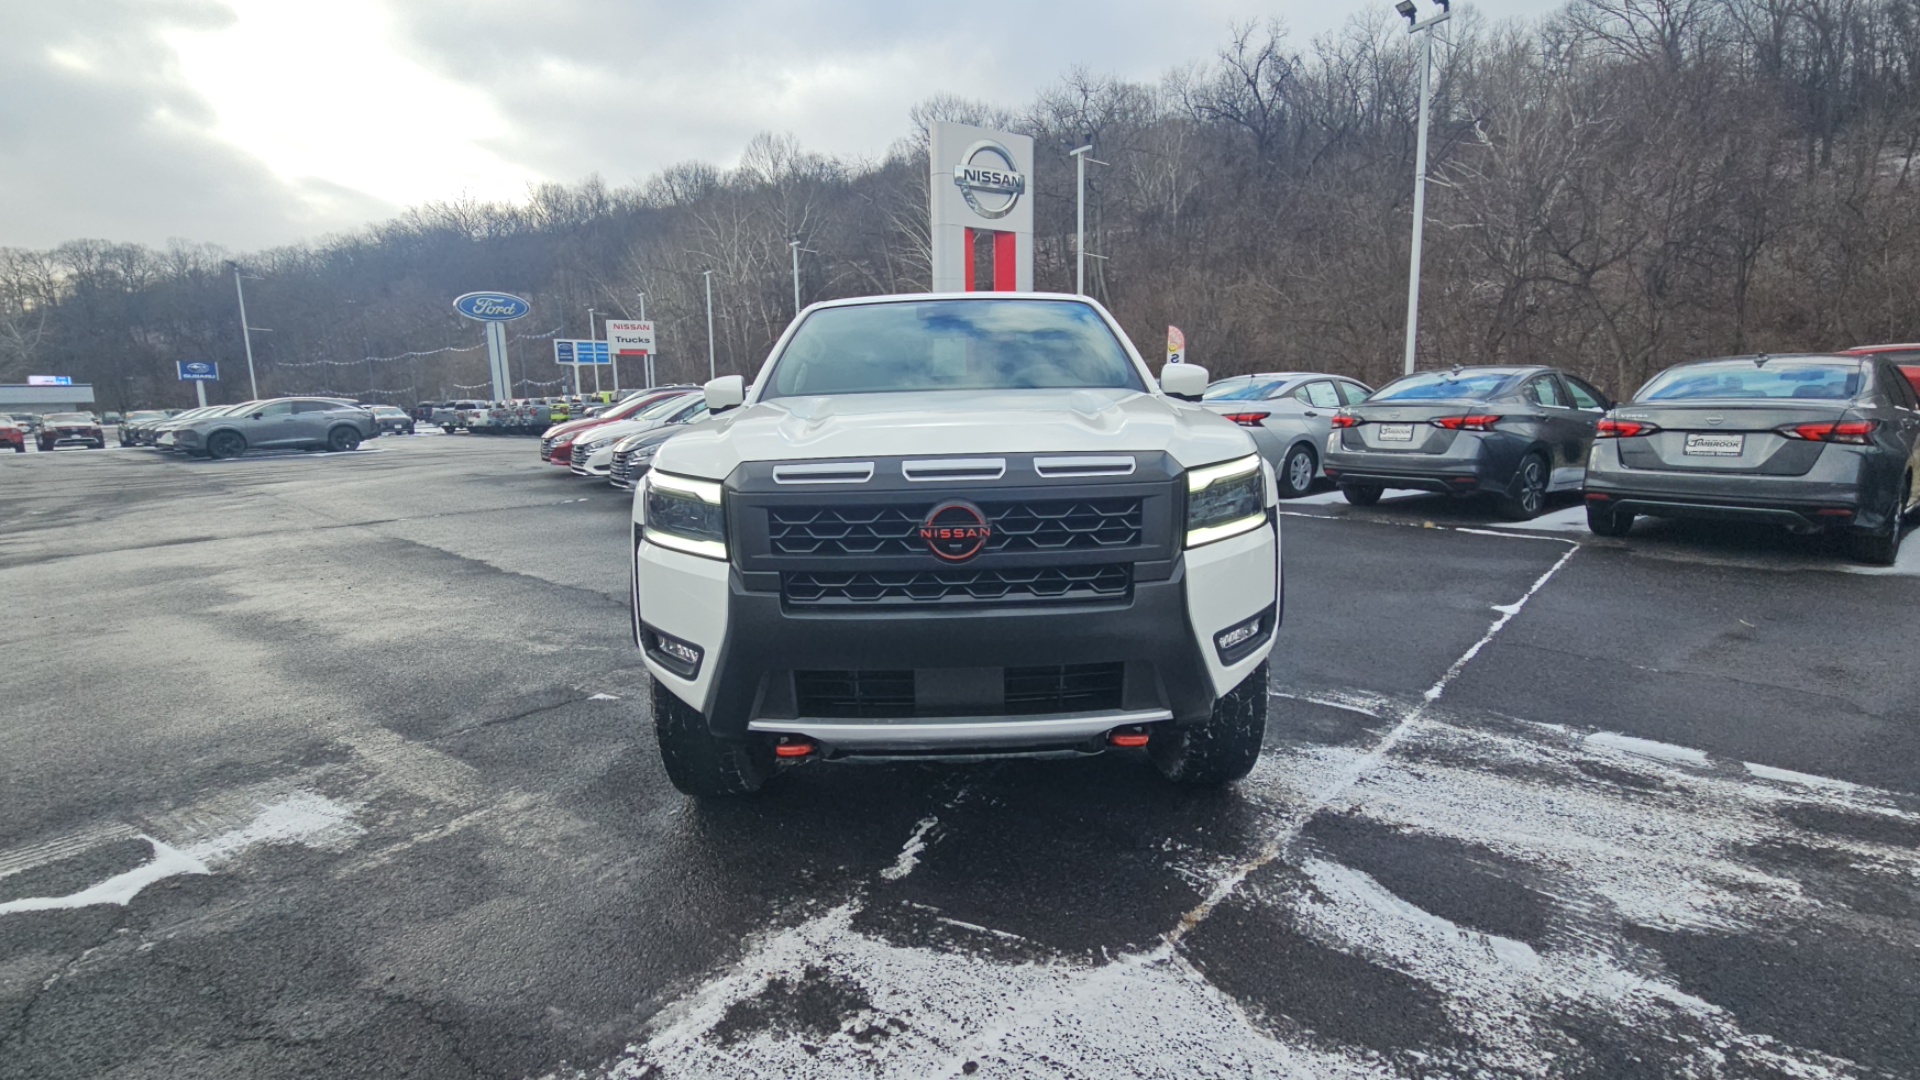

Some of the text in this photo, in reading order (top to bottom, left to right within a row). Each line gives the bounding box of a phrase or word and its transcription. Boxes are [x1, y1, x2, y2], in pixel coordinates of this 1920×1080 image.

[963, 169, 1020, 188] NISSAN
[473, 297, 516, 315] Ford
[613, 323, 650, 331] NISSAN
[615, 336, 650, 344] Trucks
[1687, 438, 1739, 448] TIMBROOK
[920, 528, 991, 539] NISSAN
